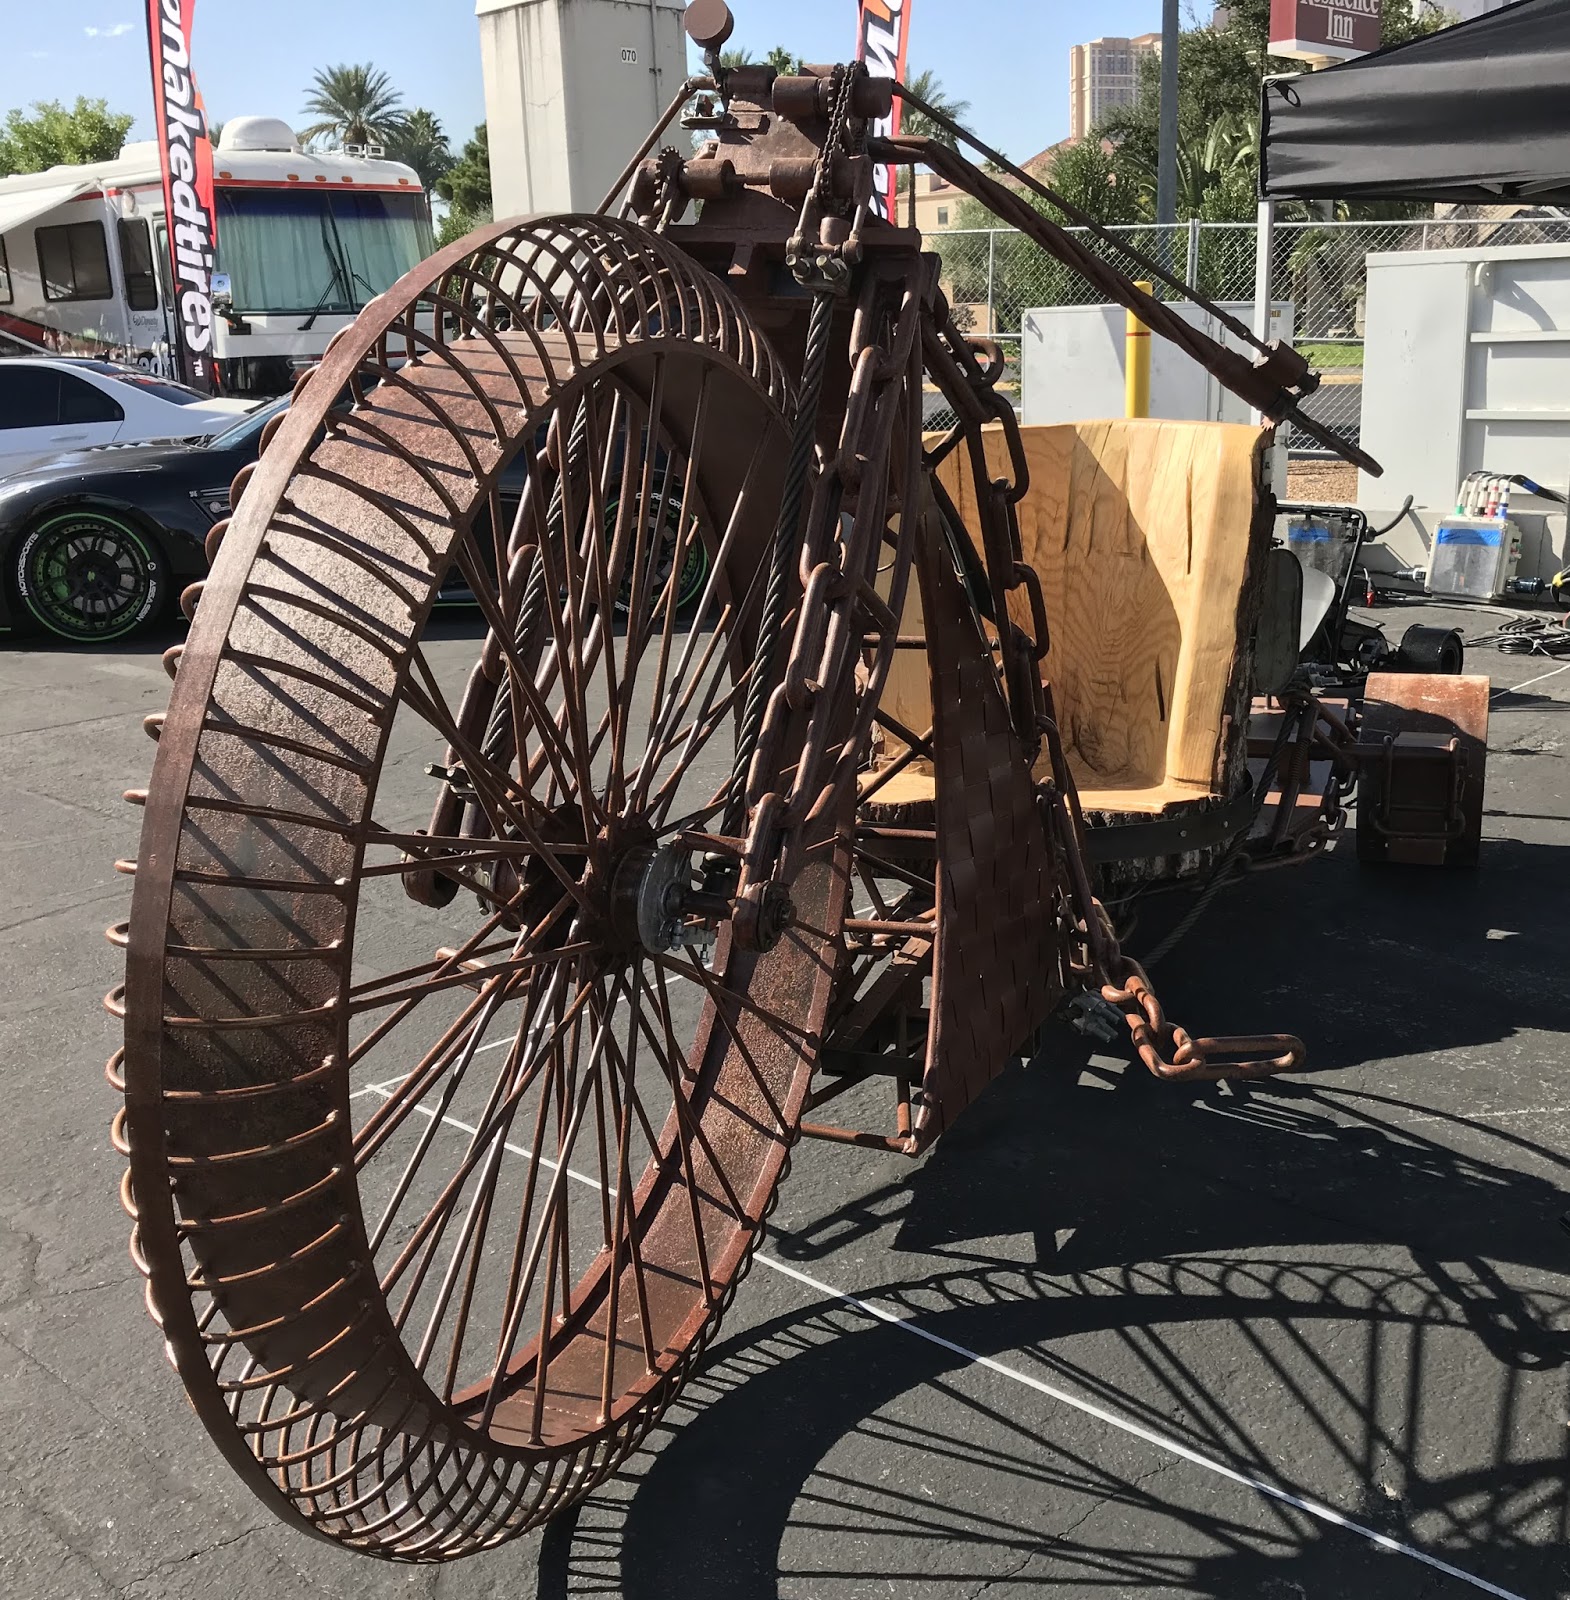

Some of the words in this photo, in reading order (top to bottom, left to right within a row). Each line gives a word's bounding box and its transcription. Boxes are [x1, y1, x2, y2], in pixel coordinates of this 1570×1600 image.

[1326, 6, 1354, 42] Inn
[621, 49, 637, 62] 070
[17, 531, 39, 596] MOTORSPORTS
[135, 579, 157, 622] ASSASSIN
